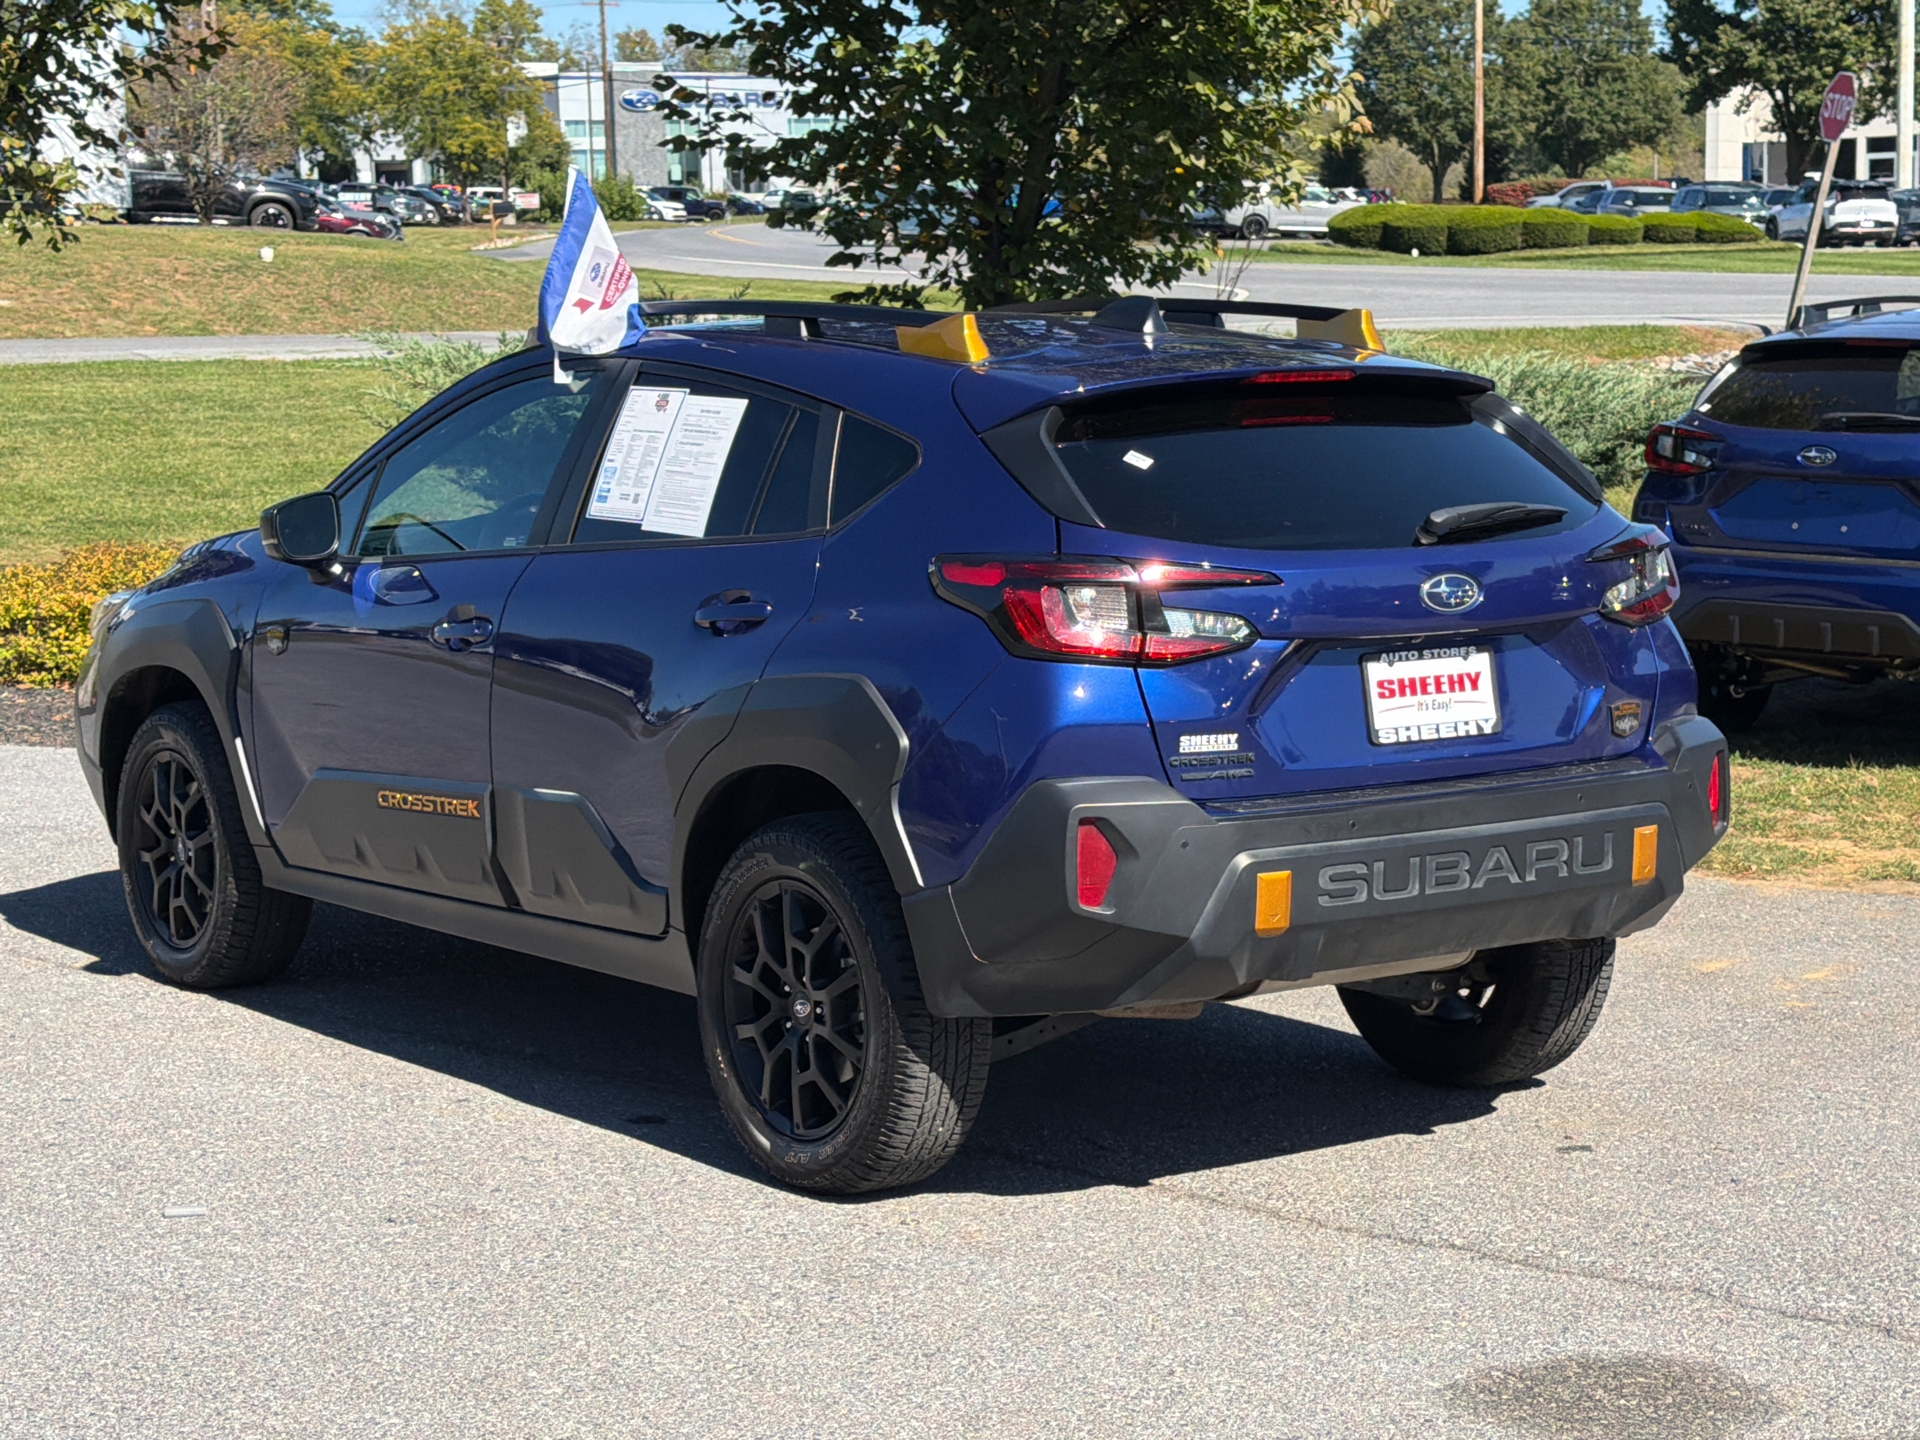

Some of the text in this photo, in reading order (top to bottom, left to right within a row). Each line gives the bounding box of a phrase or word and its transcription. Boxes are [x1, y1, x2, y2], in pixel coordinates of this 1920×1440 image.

[1823, 93, 1855, 121] STOP
[605, 258, 626, 302] CERTIFIED
[1380, 646, 1477, 664] AUTO STORES
[1376, 671, 1482, 700] SHEEHY
[1417, 698, 1453, 712] It's Easy!
[1179, 733, 1239, 747] SHEEHY
[1377, 718, 1497, 744] SHEEHY
[1169, 752, 1255, 768] CROSSTREK
[377, 790, 481, 818] CROSSTREK
[1317, 831, 1614, 907] SUBARU
